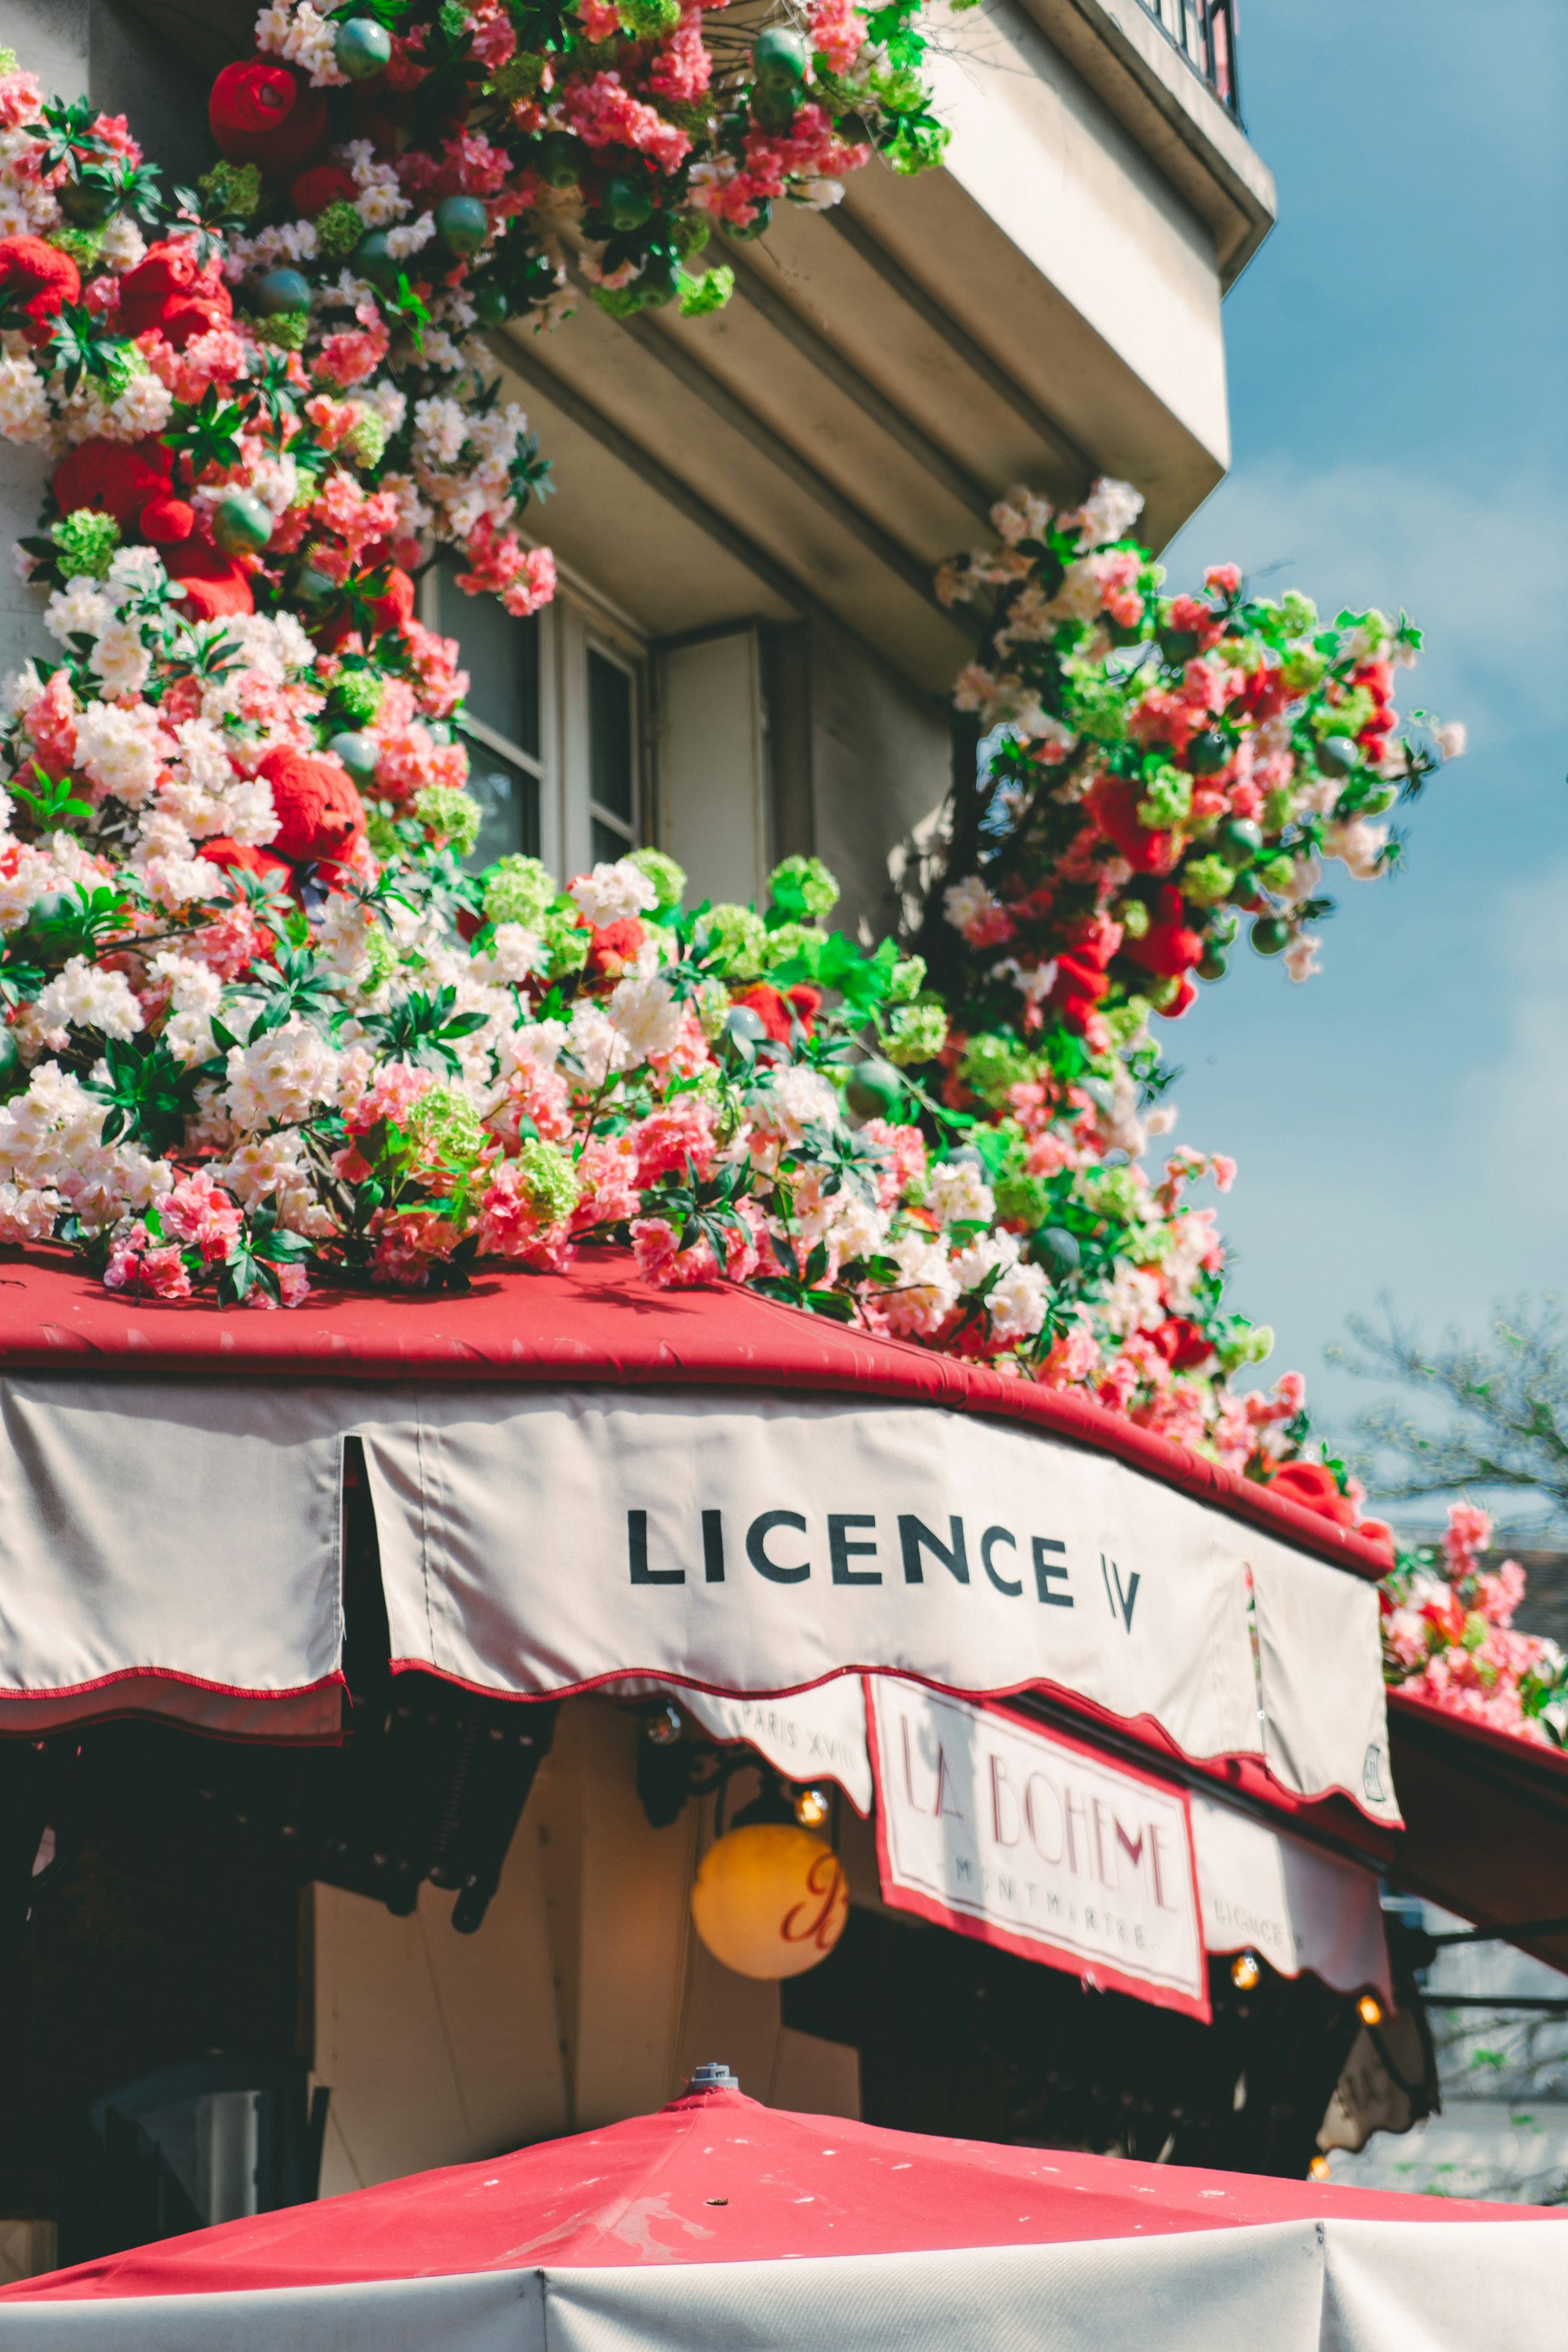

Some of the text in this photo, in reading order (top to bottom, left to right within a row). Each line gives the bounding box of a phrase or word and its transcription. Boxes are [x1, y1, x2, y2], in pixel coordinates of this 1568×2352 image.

[627, 1509, 1141, 1635] LICENCE IV
[742, 1701, 857, 1773] PARIS XVIII
[901, 1714, 965, 1828] LA
[955, 1855, 1146, 1951] MONTMARTRE
